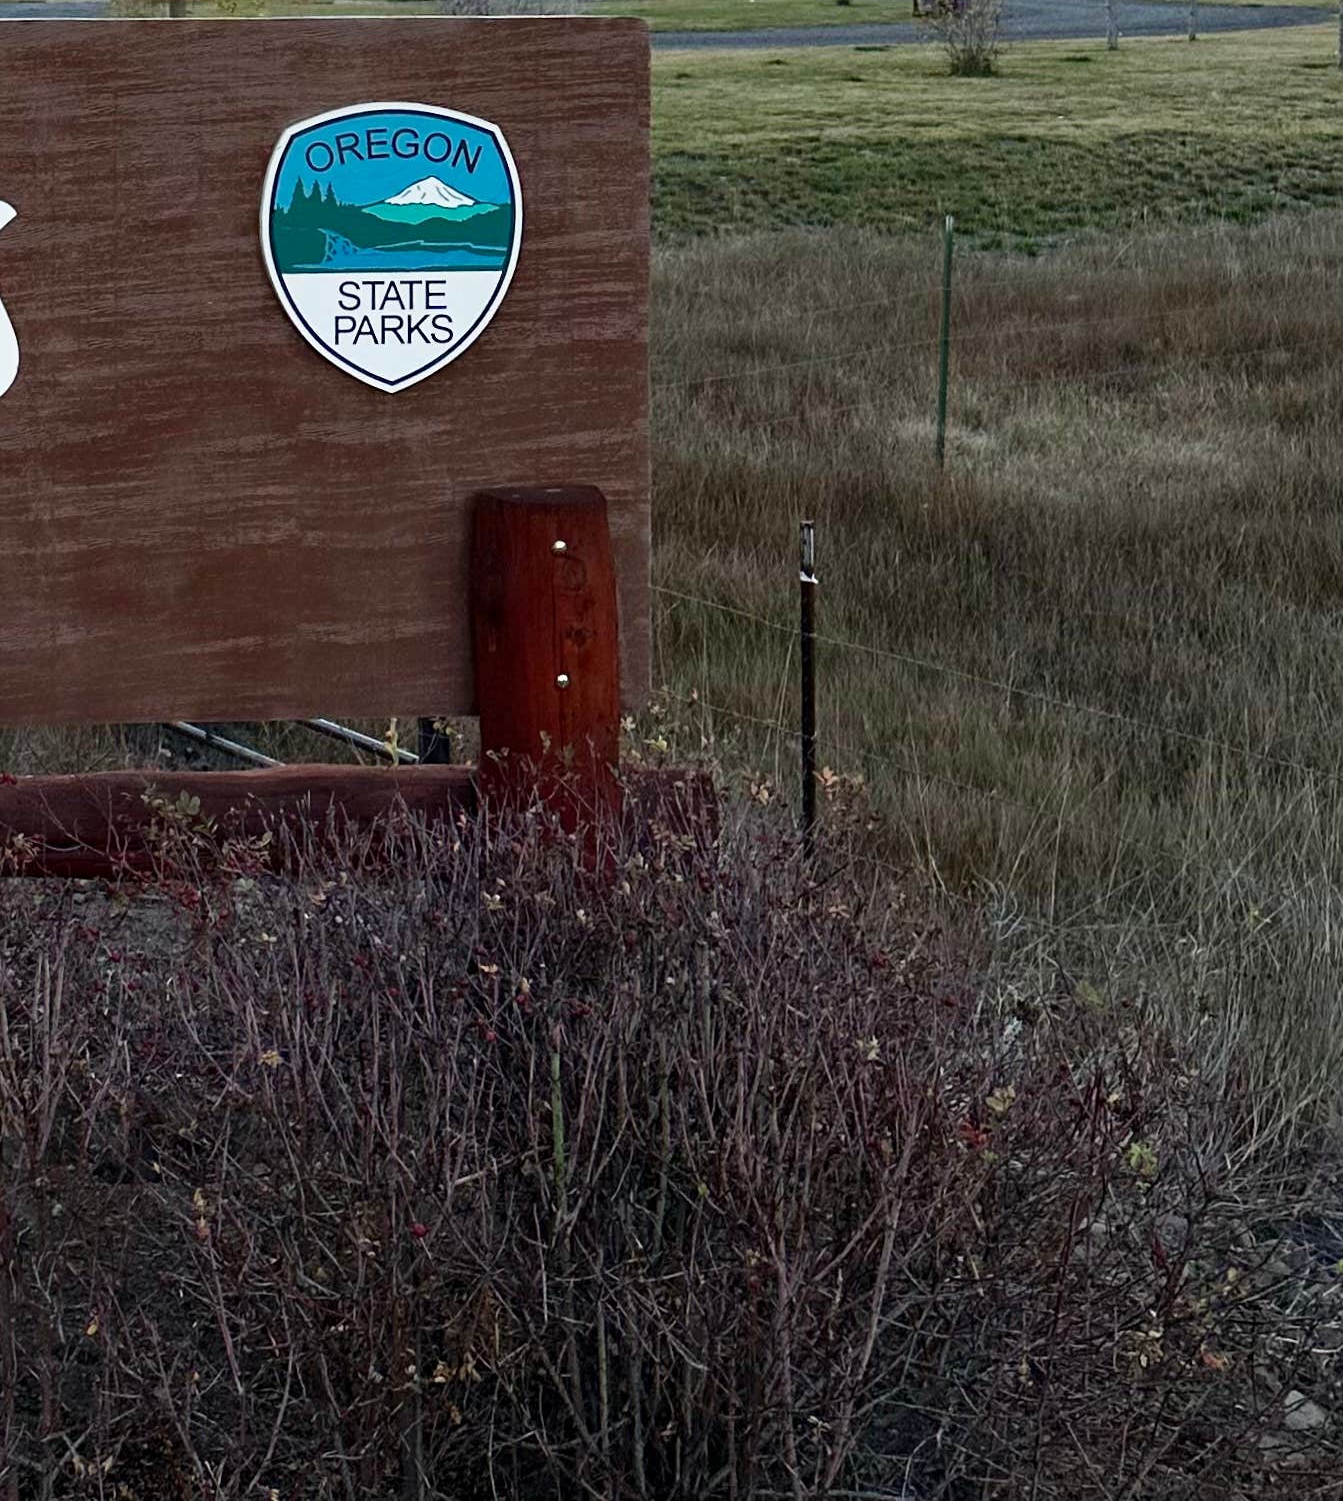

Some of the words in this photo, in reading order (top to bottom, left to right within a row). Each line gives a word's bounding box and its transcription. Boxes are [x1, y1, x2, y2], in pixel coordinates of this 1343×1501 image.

[305, 127, 482, 174] OREGON
[338, 280, 447, 311] STATE
[334, 314, 454, 345] PARKS
